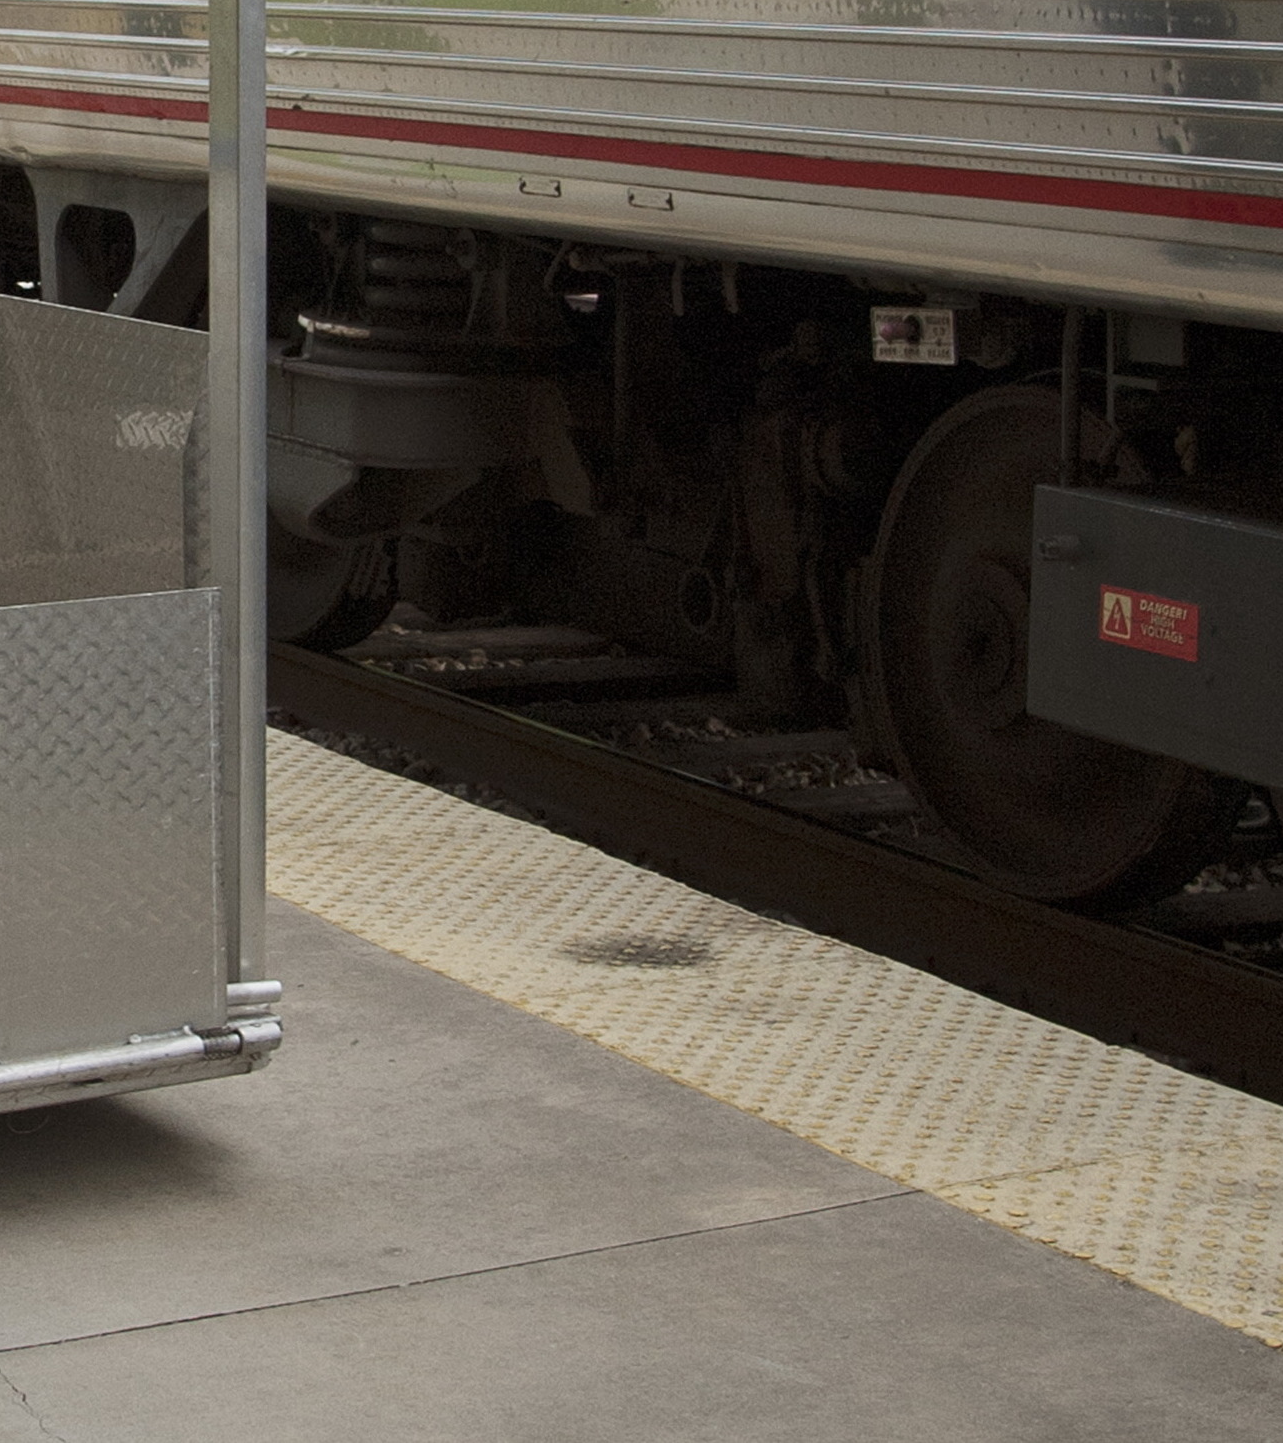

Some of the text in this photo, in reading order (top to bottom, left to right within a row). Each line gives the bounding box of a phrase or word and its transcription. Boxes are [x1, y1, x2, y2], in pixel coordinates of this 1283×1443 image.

[1139, 599, 1188, 620] DANGER!
[1150, 614, 1175, 629] HIGH
[1140, 623, 1185, 644] VOLTAGE
